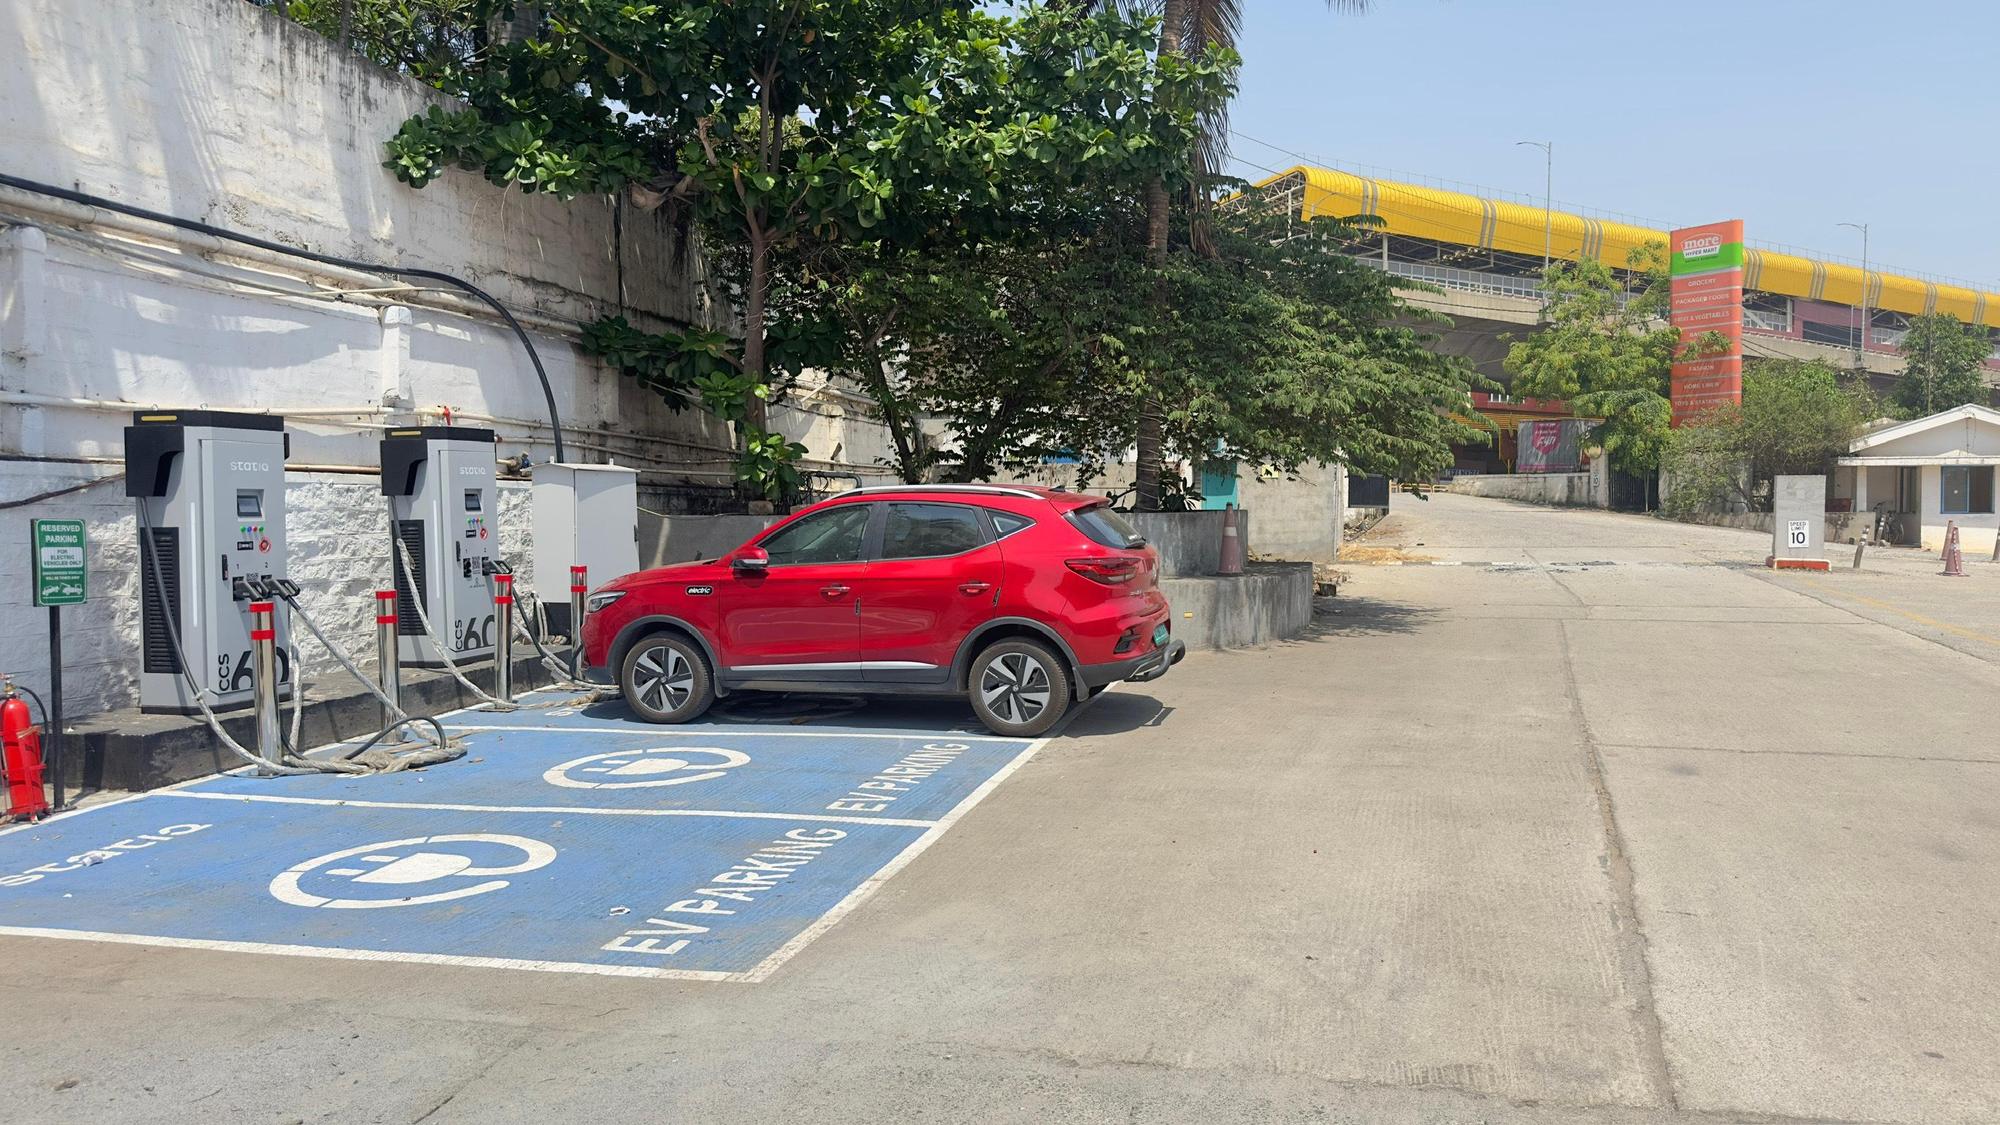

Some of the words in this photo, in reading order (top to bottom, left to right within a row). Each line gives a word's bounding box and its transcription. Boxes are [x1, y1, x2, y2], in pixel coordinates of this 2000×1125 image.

[1684, 236, 1720, 249] more
[1688, 279, 1716, 287] GROCERY
[1676, 297, 1708, 305] PACKAGED
[1695, 311, 1730, 320] VEGETABLES
[45, 535, 78, 543] PARKING
[1792, 532, 1805, 544] 10
[455, 619, 463, 650] CCS
[218, 653, 230, 691] CCS
[859, 742, 971, 792] PARKING
[826, 791, 894, 813] EV
[600, 918, 711, 956] EV
[663, 827, 848, 915] PARKING
